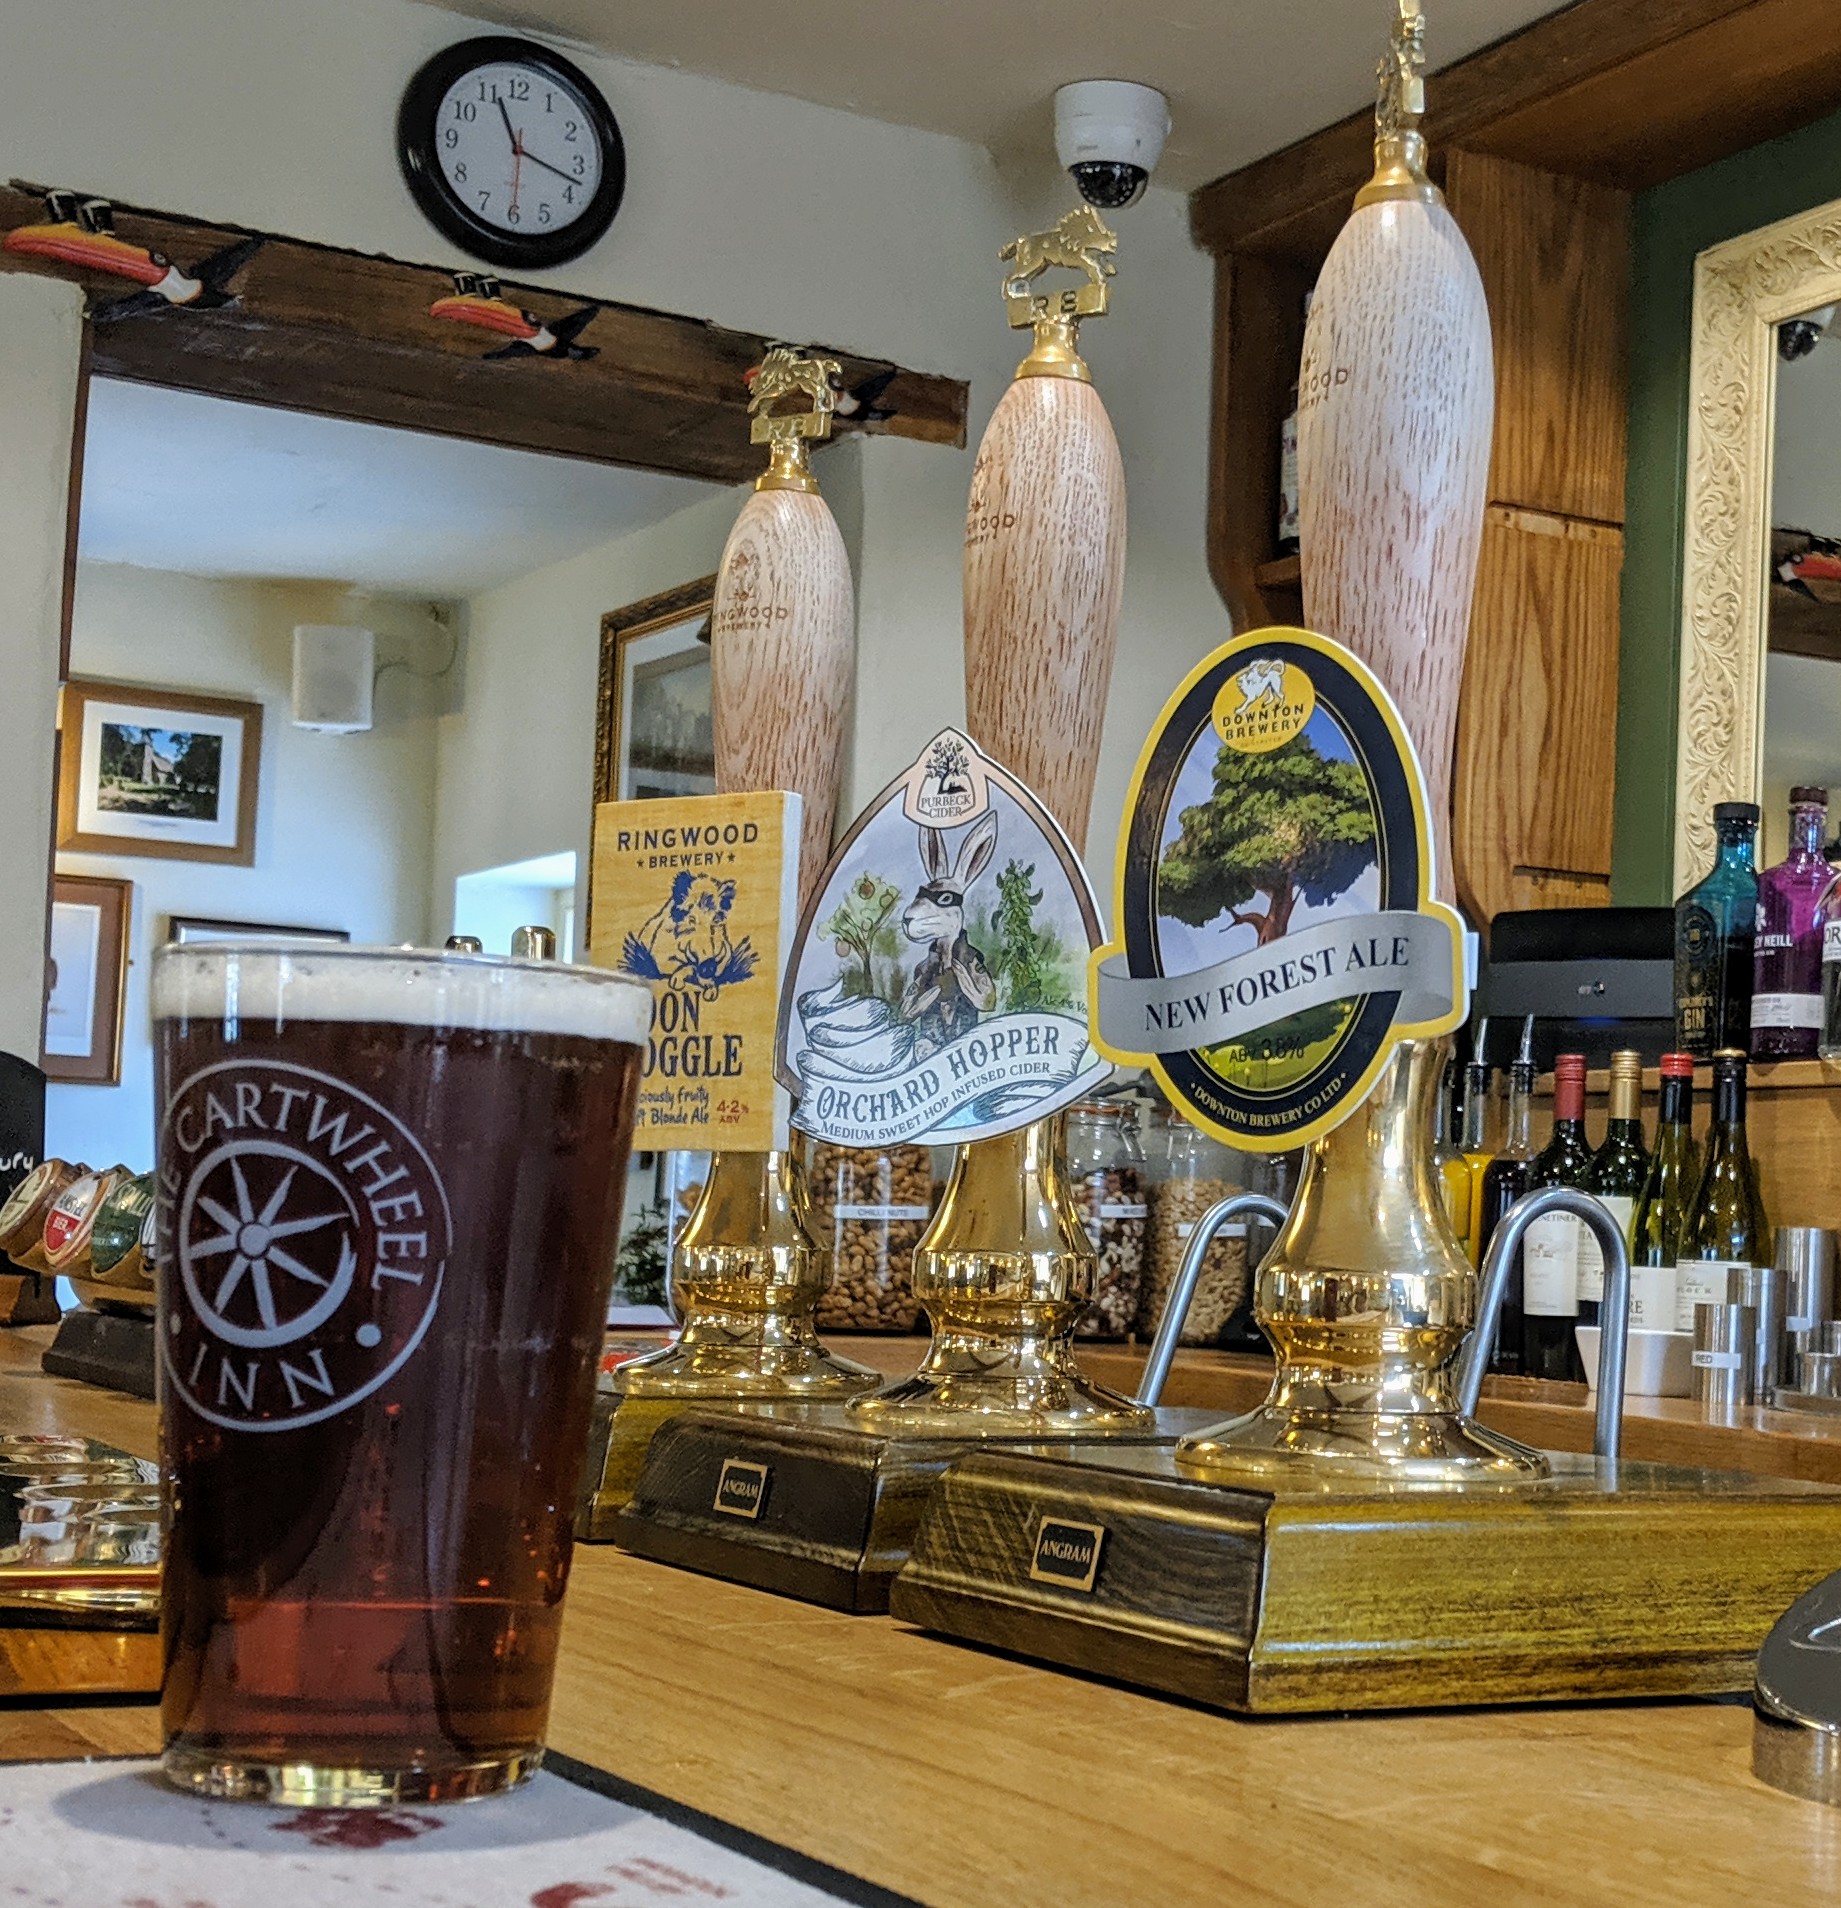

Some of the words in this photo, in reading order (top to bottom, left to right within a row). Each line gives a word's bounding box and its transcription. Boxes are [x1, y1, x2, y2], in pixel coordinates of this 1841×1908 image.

[478, 82, 498, 104] 11
[508, 79, 530, 101] 12
[453, 101, 476, 122] 10
[546, 93, 554, 113] 1
[445, 128, 458, 148] 9
[565, 121, 577, 142] 2
[454, 163, 467, 183] 8
[573, 155, 585, 175] 3
[478, 191, 491, 210] 7
[562, 185, 573, 203] 4
[508, 204, 520, 224] 6
[539, 204, 550, 223] 5
[1222, 703, 1304, 727] DOWNTON
[1225, 717, 1300, 740] BREWERY
[920, 793, 971, 808] PURBECK
[929, 806, 962, 818] CIDER
[617, 823, 758, 851] RINGWOOD
[648, 851, 724, 869] BREWERY
[1145, 991, 1210, 1031] NEW
[1218, 947, 1337, 1015] FOREST
[1345, 936, 1409, 972] ALE
[1684, 1008, 1705, 1030] GIN
[816, 1069, 940, 1123] ORCHARD
[946, 1025, 1060, 1081] HOPPER
[820, 1120, 876, 1140] MEDIUM
[878, 1114, 921, 1139] SWEET
[923, 1096, 949, 1120] HOP
[951, 1067, 1006, 1101] INFUSED
[1010, 1062, 1050, 1076] CIDER
[1194, 1087, 1247, 1124] DOWNTON
[1249, 1105, 1303, 1127] BREWERY
[1304, 1096, 1321, 1114] CO
[1320, 1079, 1342, 1105] LTD
[176, 1082, 428, 1291] CARTWHEEL
[188, 1343, 335, 1411] INN
[721, 1478, 759, 1500] ANGRAM
[1040, 1539, 1092, 1565] ANGRAM
